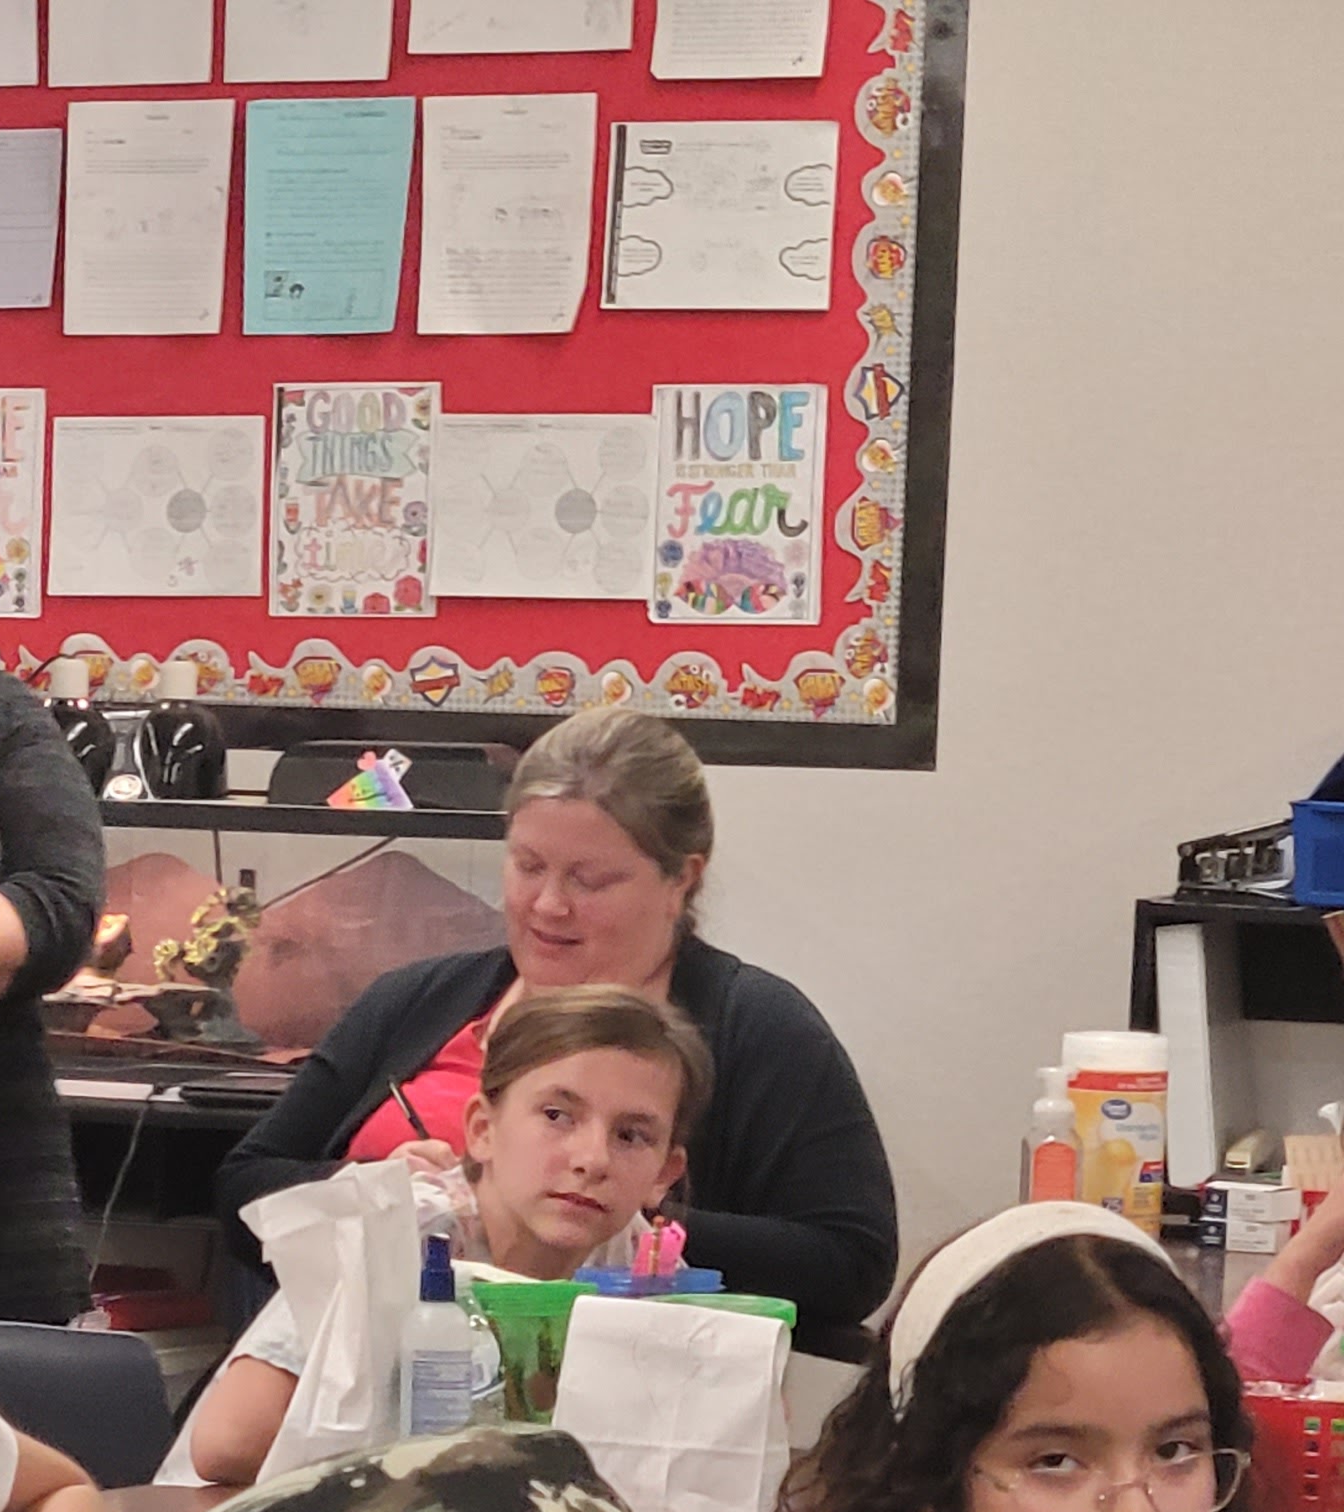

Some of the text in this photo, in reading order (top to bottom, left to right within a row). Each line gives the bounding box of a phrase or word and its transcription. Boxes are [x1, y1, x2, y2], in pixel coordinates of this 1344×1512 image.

[306, 390, 408, 434] GOOD
[674, 390, 810, 462] HOPE
[305, 434, 393, 473] THINGS
[302, 473, 404, 529] TAKE
[665, 480, 809, 538] Fear
